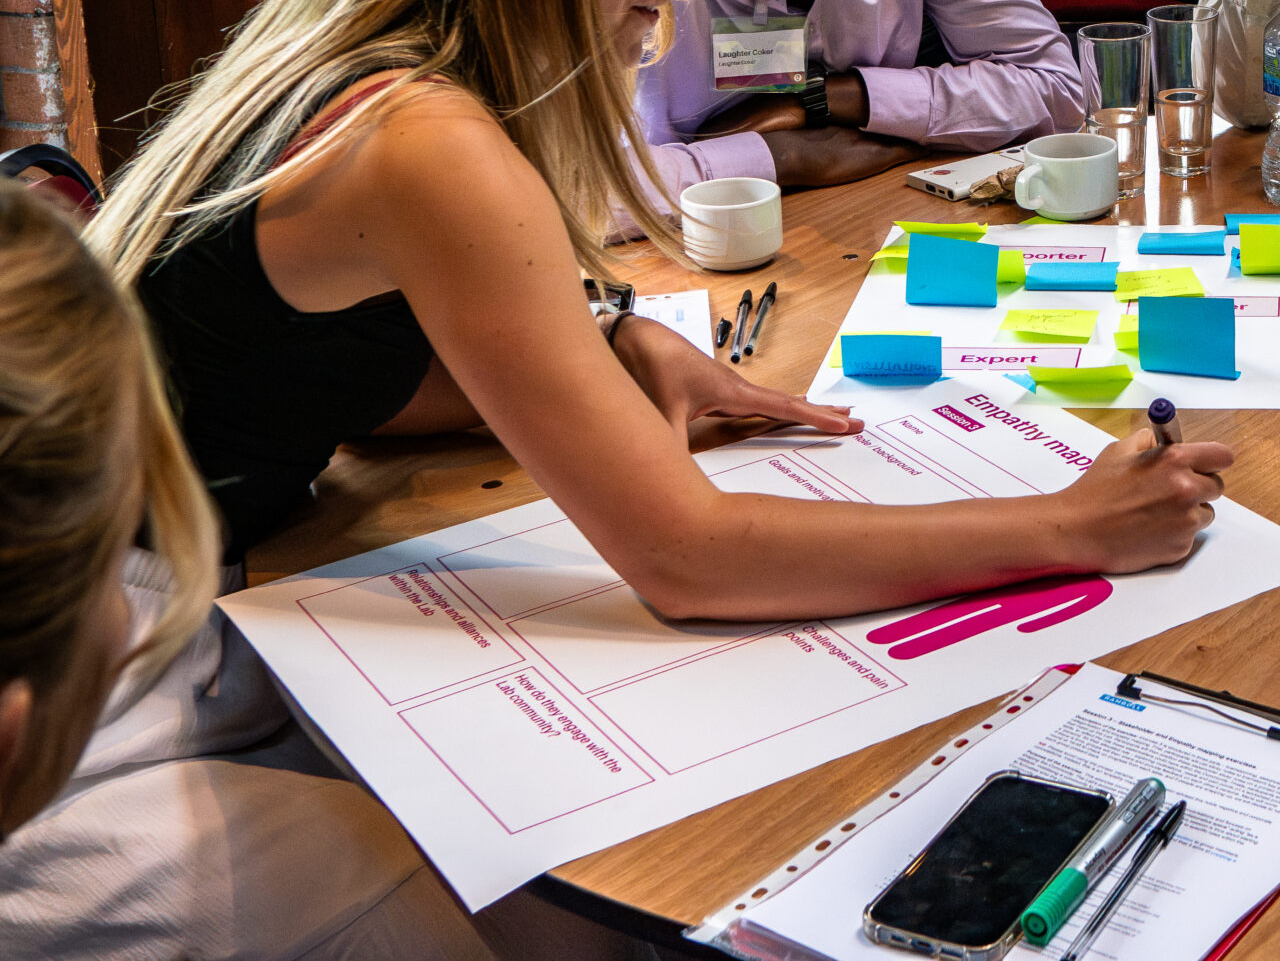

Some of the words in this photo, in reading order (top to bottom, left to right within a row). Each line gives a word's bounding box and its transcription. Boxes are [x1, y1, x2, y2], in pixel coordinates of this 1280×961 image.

[718, 50, 751, 59] Laughter
[752, 48, 774, 56] Coker
[1022, 252, 1088, 260] porter
[960, 354, 1039, 365] Expert
[899, 420, 924, 435] Name
[937, 406, 970, 426] Session
[964, 393, 1052, 441] Empathy
[853, 435, 872, 447] Role
[872, 447, 923, 476] background
[768, 459, 791, 475] Goals
[788, 471, 808, 484] and
[802, 483, 834, 501] motiva
[388, 574, 413, 595] within
[405, 592, 422, 605] the
[416, 602, 436, 617] Lab
[406, 569, 451, 610] Relationships
[444, 608, 466, 622] and
[456, 620, 492, 648] alliances
[782, 631, 815, 653] points
[802, 625, 852, 662] Challenges
[847, 660, 871, 674] and
[861, 672, 889, 689] pain
[495, 680, 515, 696] Lab
[509, 694, 561, 738] community?
[514, 673, 537, 692] How
[530, 691, 546, 702] do
[540, 699, 563, 717] they
[557, 715, 591, 744] engage
[586, 742, 610, 761] with
[602, 758, 622, 773] the
[1082, 708, 1108, 720] Session
[1118, 720, 1155, 735] Stakeholder
[1156, 731, 1168, 740] and
[1168, 735, 1196, 750] Empathy
[1197, 746, 1226, 760] mapping
